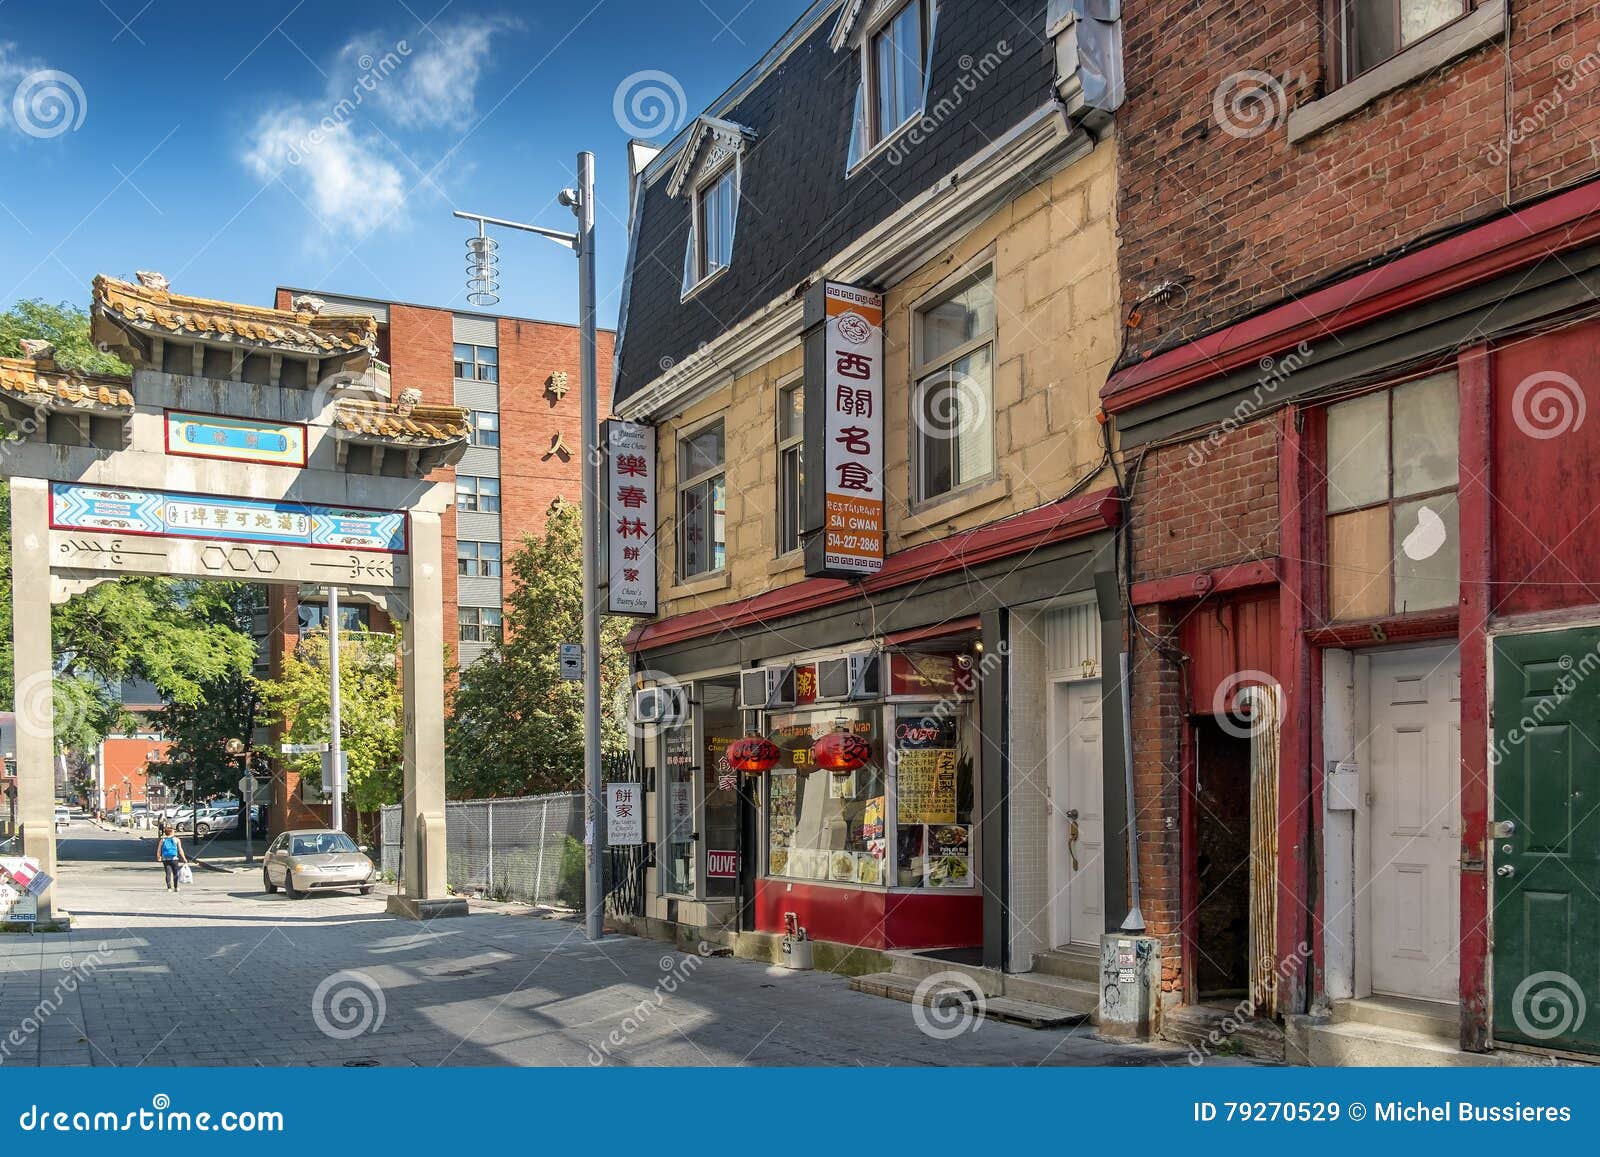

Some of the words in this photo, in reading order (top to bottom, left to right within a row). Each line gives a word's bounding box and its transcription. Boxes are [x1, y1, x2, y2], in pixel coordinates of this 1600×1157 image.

[831, 514, 845, 529] SAI
[848, 517, 878, 531] GWAN
[827, 533, 880, 552] 514-227-2868
[709, 855, 741, 873] OUVE
